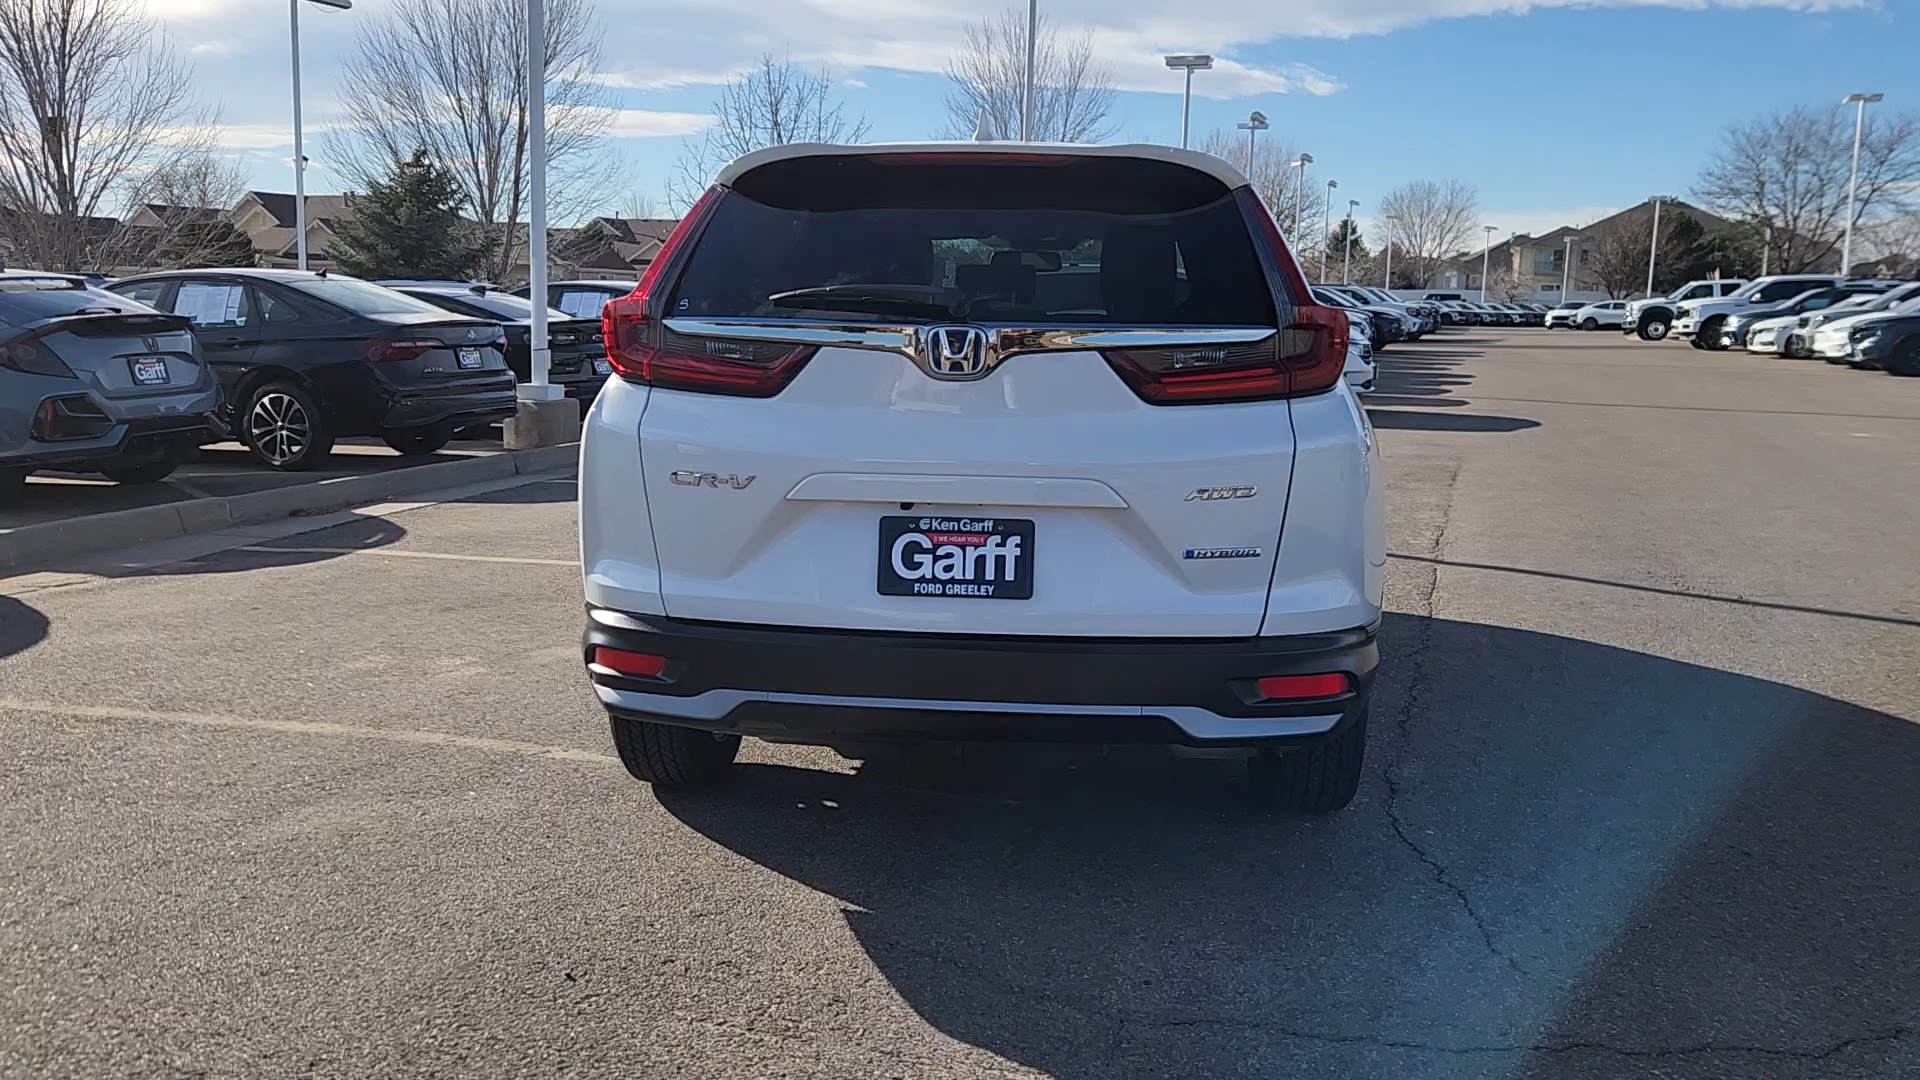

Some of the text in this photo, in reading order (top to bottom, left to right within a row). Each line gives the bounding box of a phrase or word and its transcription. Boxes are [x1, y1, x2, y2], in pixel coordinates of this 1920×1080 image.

[134, 361, 166, 380] Garff
[669, 470, 757, 490] CR-V
[1184, 486, 1258, 502] AWD
[931, 518, 994, 532] Ken Garff
[891, 532, 1021, 581] Garff
[1195, 549, 1259, 559] HYBRID
[914, 583, 995, 596] FORD GREELEY
